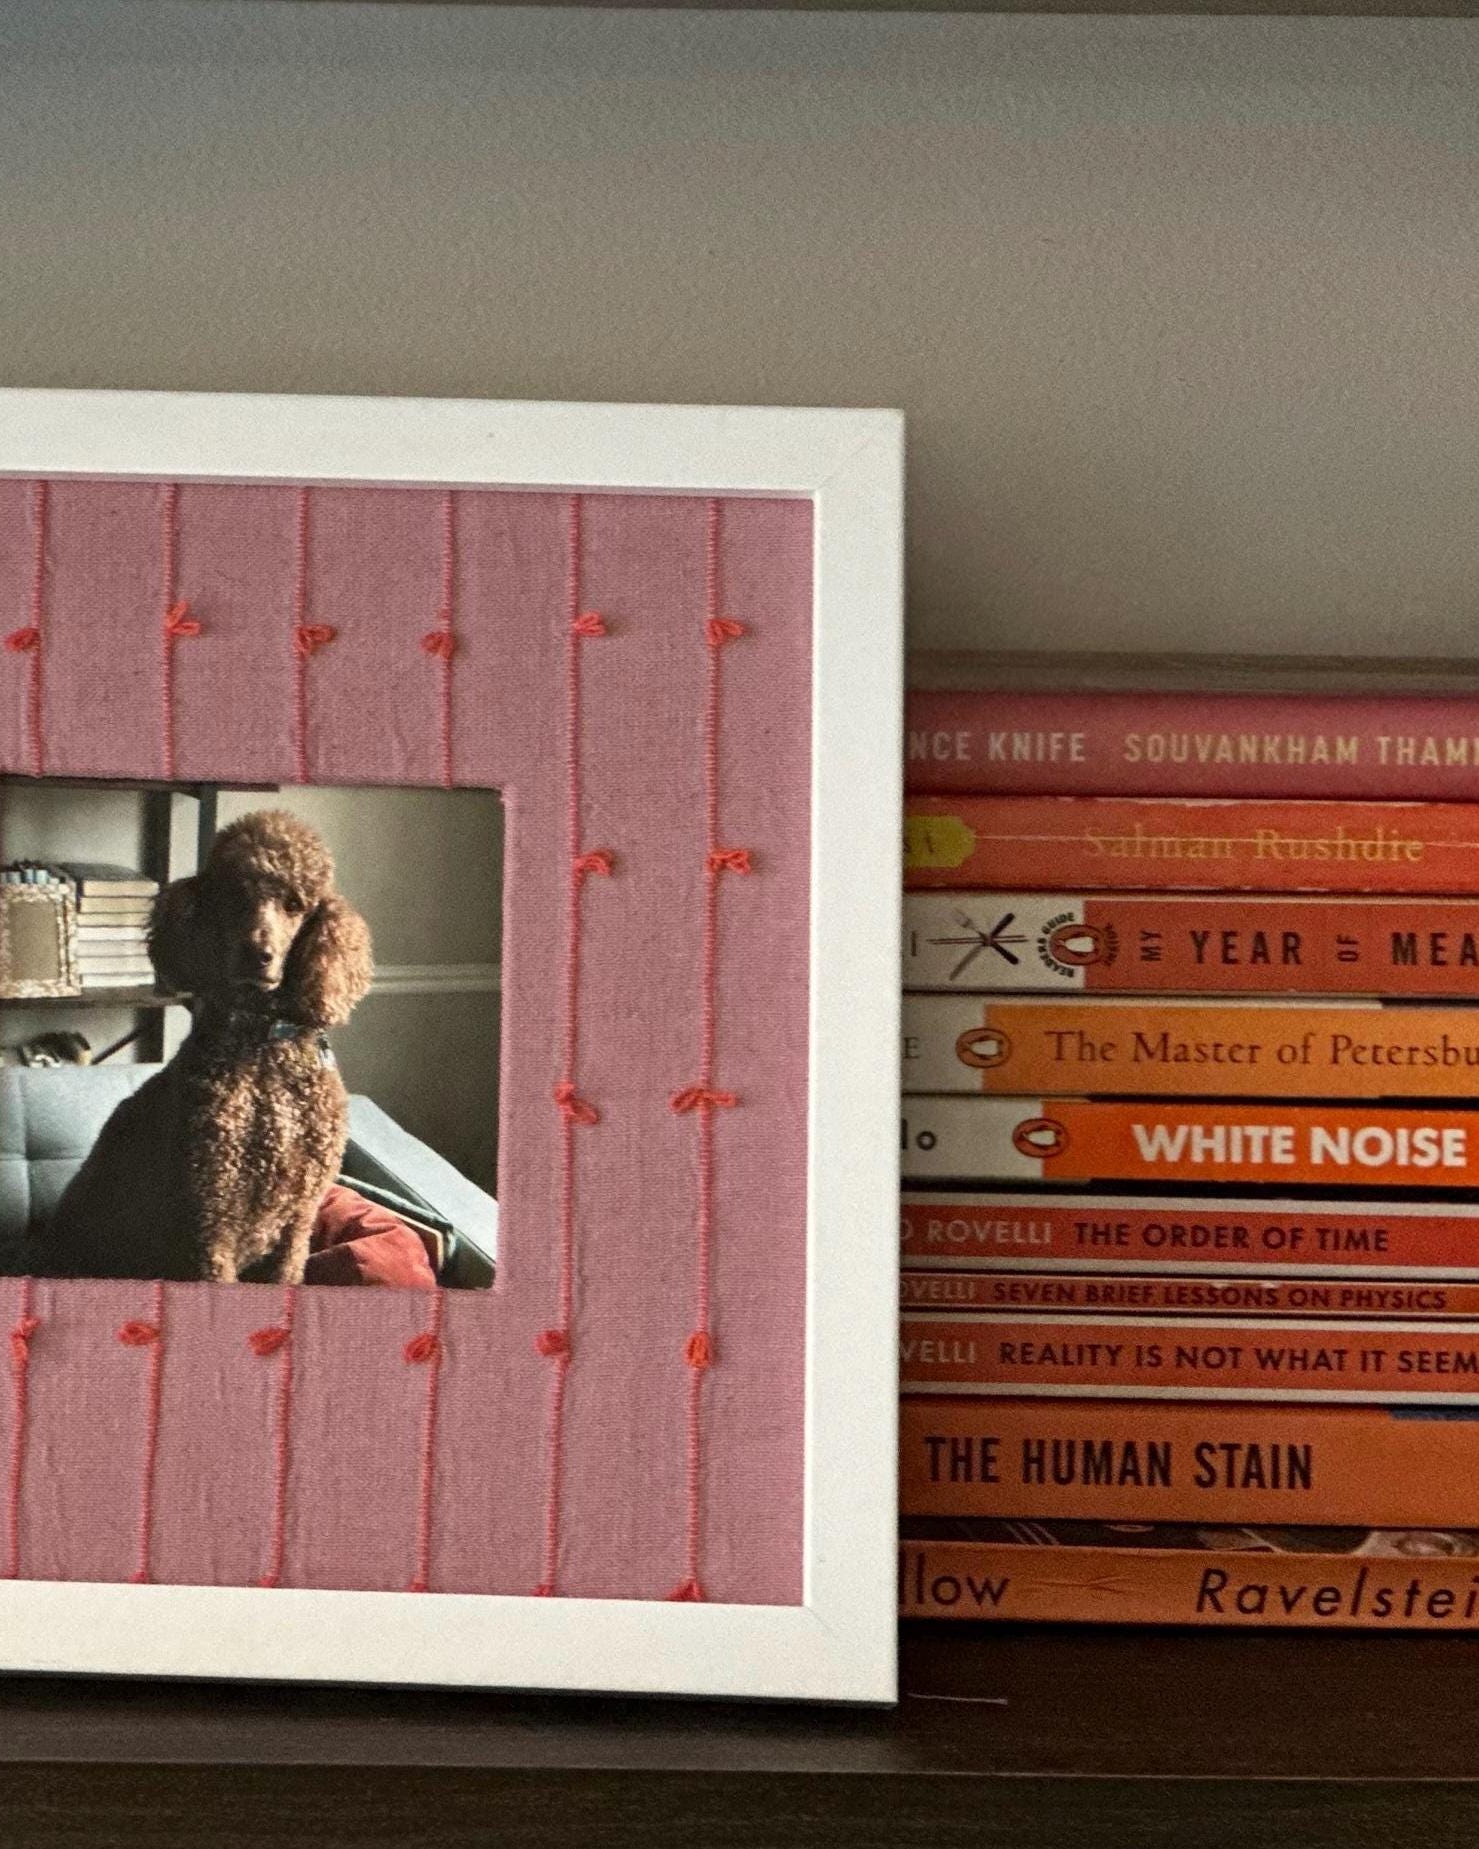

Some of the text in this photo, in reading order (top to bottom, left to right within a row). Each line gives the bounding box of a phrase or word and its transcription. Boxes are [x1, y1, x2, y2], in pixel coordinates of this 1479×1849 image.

[988, 732, 1086, 762] KNIFE
[1123, 734, 1359, 765] SOUVANKHAM
[1376, 736, 1479, 766] THAM
[1085, 823, 1424, 862] Salman Rushdie
[1139, 930, 1162, 962] MY
[1189, 930, 1303, 965] YEAR
[1337, 935, 1358, 963] OF
[1391, 932, 1479, 966] MEA
[1045, 1031, 1117, 1064] The
[1132, 1034, 1263, 1065] Master
[1276, 1033, 1312, 1065] of
[1131, 1124, 1467, 1168] WHITE NOISE
[926, 1218, 1052, 1246] ROVELLI
[1073, 1222, 1130, 1247] THE
[1142, 1223, 1248, 1250] ORDER
[1261, 1226, 1304, 1251] OF
[1315, 1227, 1388, 1253] TIME
[993, 1281, 1076, 1303] SEVEN
[1085, 1283, 1156, 1304] BRIEF
[1162, 1285, 1279, 1307] LESSONS
[1286, 1287, 1329, 1309] ON
[1340, 1288, 1447, 1311] PHYSICS
[999, 1342, 1122, 1367] REALITY
[1135, 1344, 1163, 1368] IS
[1174, 1346, 1242, 1370] NOT
[1254, 1348, 1345, 1372] WHAT
[1359, 1350, 1389, 1373] IT
[1398, 1350, 1479, 1374] SEEM
[923, 1436, 1313, 1490] THE HUMAN STAIN
